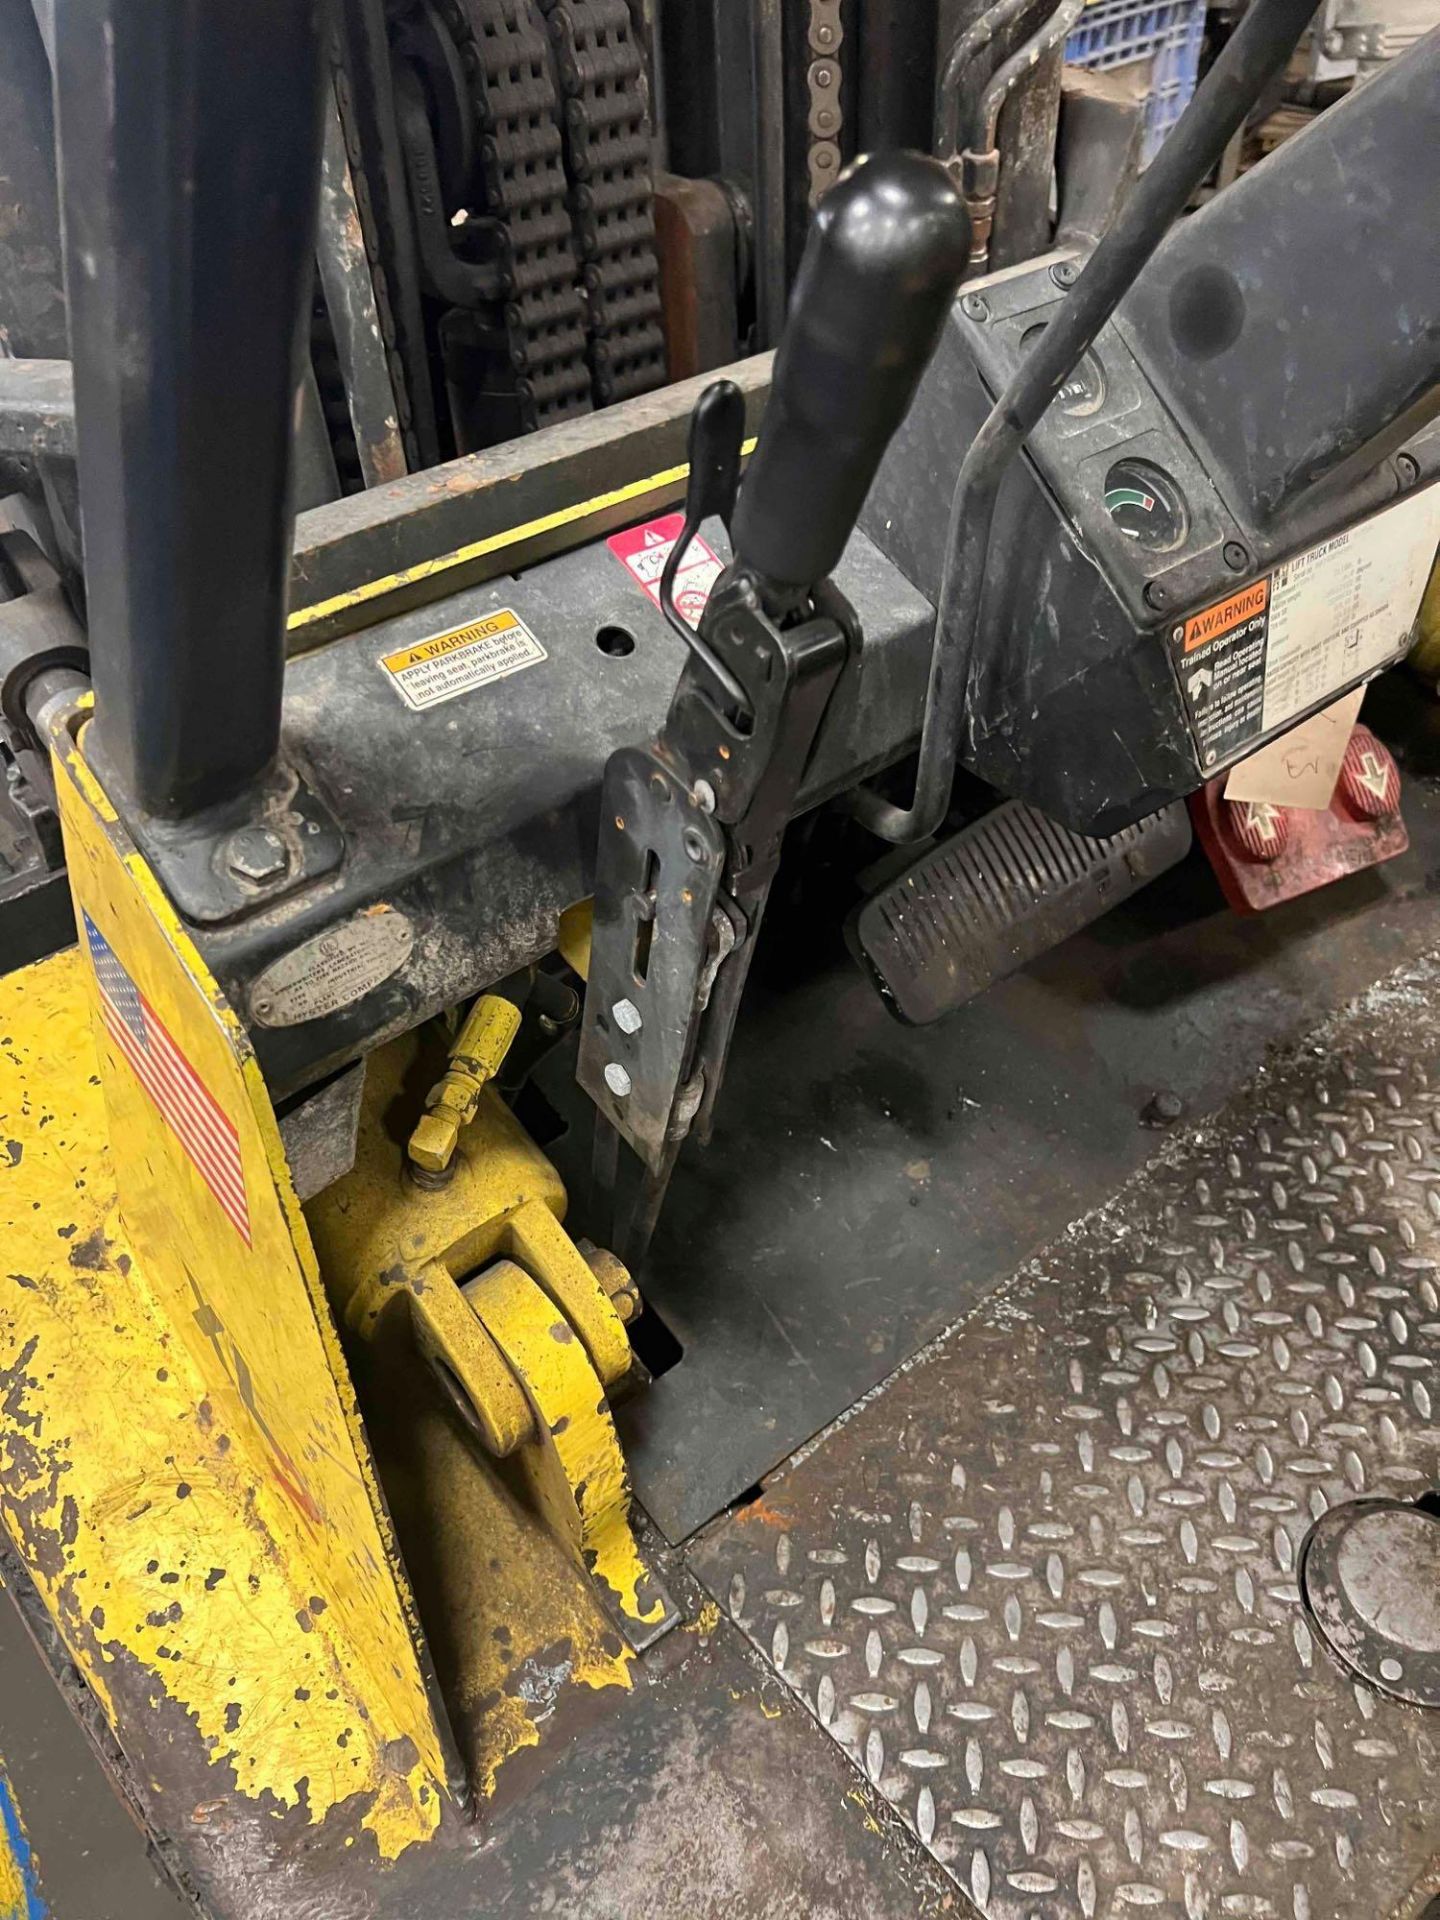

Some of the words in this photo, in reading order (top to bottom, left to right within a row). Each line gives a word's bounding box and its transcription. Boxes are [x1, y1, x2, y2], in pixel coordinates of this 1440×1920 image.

[1292, 557, 1305, 572] LIFT
[1307, 546, 1327, 563] TRUCK
[1202, 589, 1264, 634] WARNING
[424, 622, 499, 655] WARNING
[1181, 645, 1211, 669] Trained
[1212, 626, 1247, 651] Operator
[1248, 616, 1266, 632] Only
[1214, 655, 1231, 671] Read
[1233, 638, 1264, 661] Operating
[401, 664, 431, 681] APPLY
[432, 641, 493, 669] PARKBRAKE
[492, 630, 522, 646] before
[411, 672, 447, 689] leaving
[471, 643, 516, 668] parkbrake
[517, 640, 527, 648] is
[1214, 660, 1238, 681] Manual
[1239, 648, 1263, 666] located
[418, 687, 436, 699] not
[435, 664, 497, 692] automatically
[1213, 680, 1222, 690] on
[1223, 675, 1231, 684] or
[1232, 665, 1247, 679] near
[294, 999, 338, 1019] HYSTER
